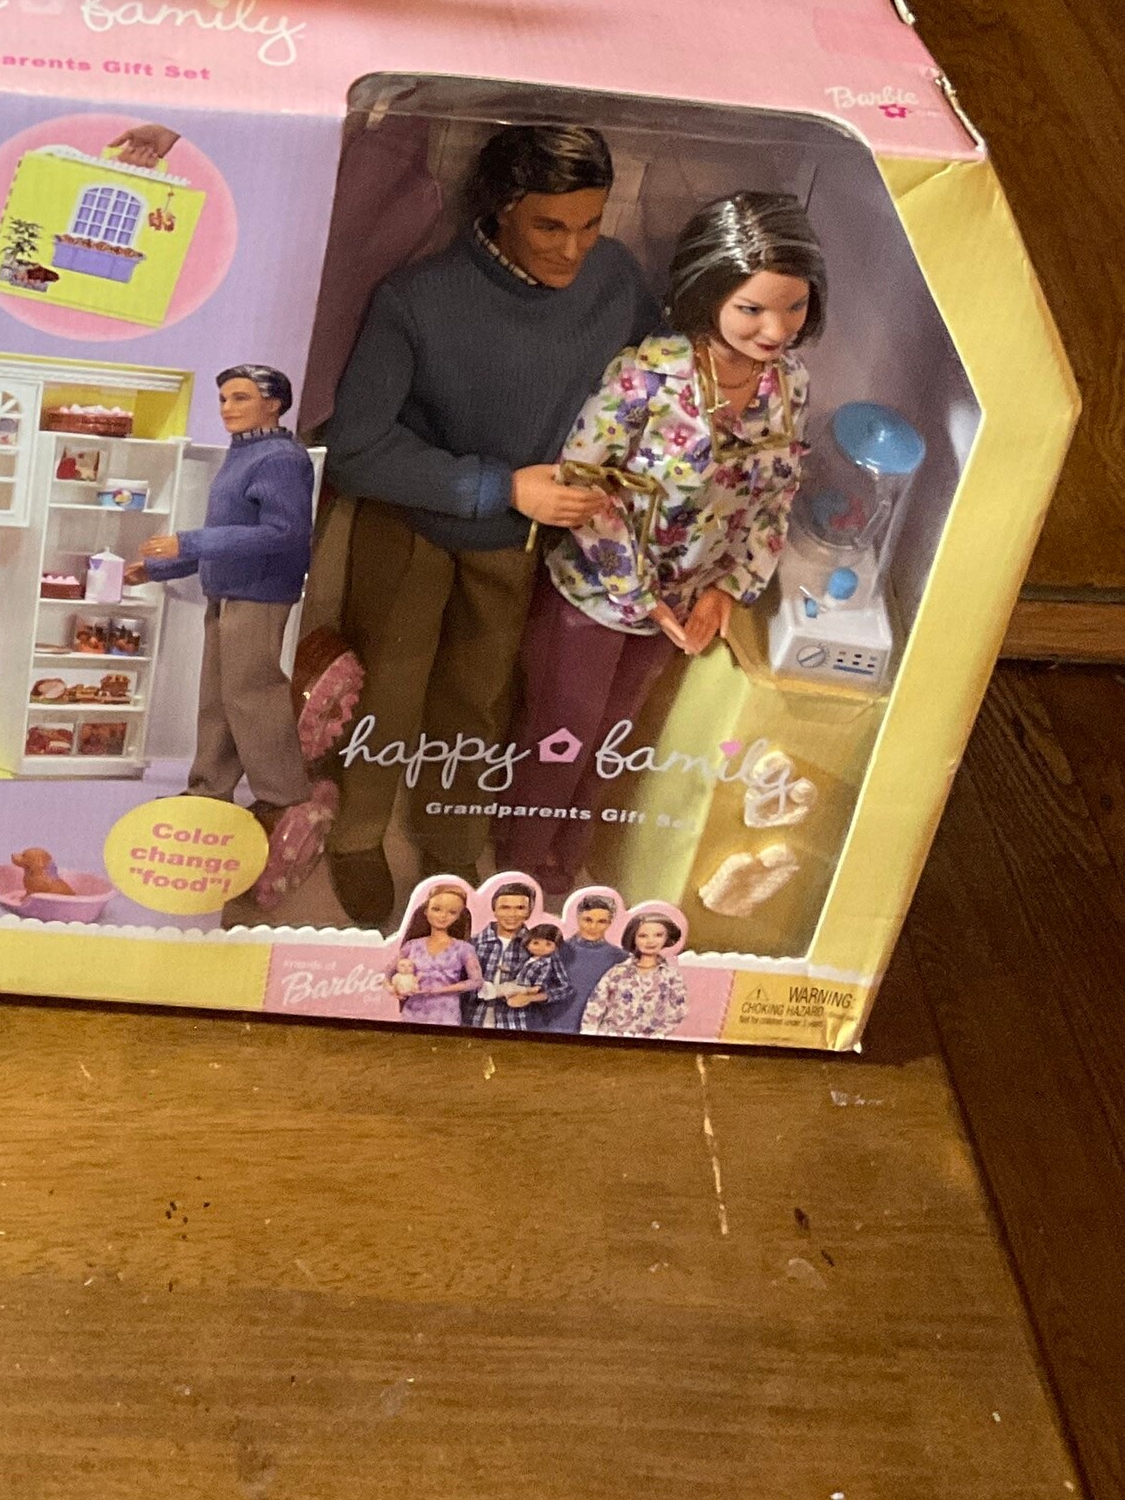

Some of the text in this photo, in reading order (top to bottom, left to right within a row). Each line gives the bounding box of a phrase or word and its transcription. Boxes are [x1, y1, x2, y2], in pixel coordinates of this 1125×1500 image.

[102, 60, 154, 77] Gift
[164, 65, 211, 80] Set
[824, 86, 919, 110] Barbie
[338, 715, 801, 823] happy family
[426, 801, 592, 820] Grandparents
[601, 808, 646, 824] Gift
[152, 823, 235, 846] Color
[130, 846, 241, 873] change
[281, 964, 385, 1006] Barbie
[741, 1002, 784, 1016] CHOKING
